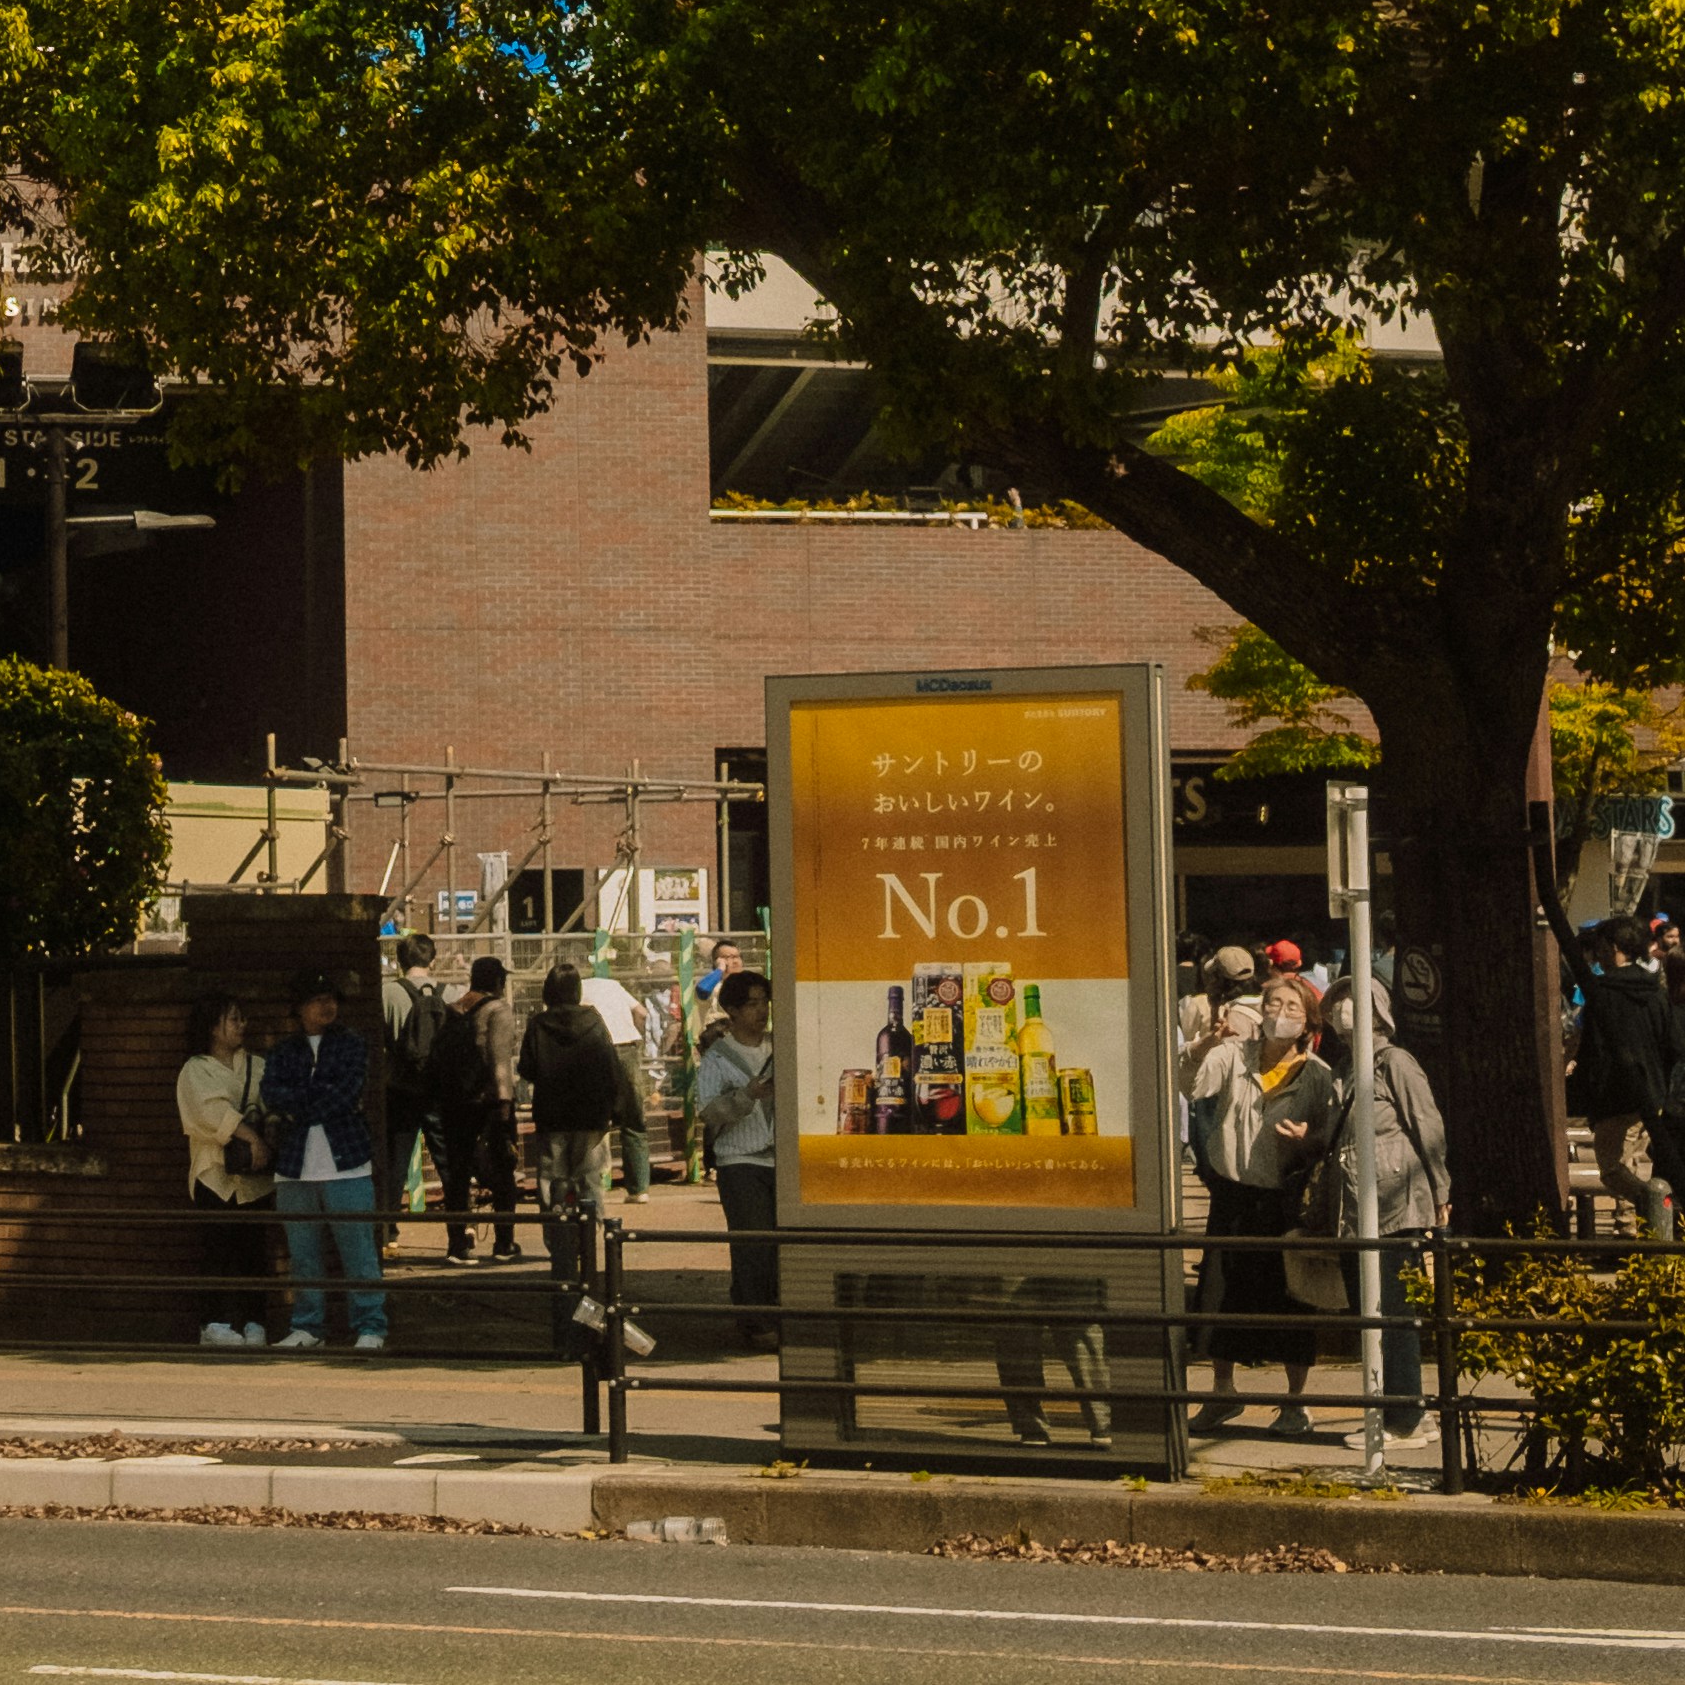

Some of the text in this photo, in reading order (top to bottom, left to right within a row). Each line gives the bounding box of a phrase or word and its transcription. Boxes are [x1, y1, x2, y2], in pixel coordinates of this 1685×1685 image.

[4, 430, 47, 447] STA
[70, 431, 121, 448] SIDE
[871, 750, 1043, 778] サントリーの
[873, 791, 1056, 816] おいしいワイン。
[876, 866, 1048, 940] No.1
